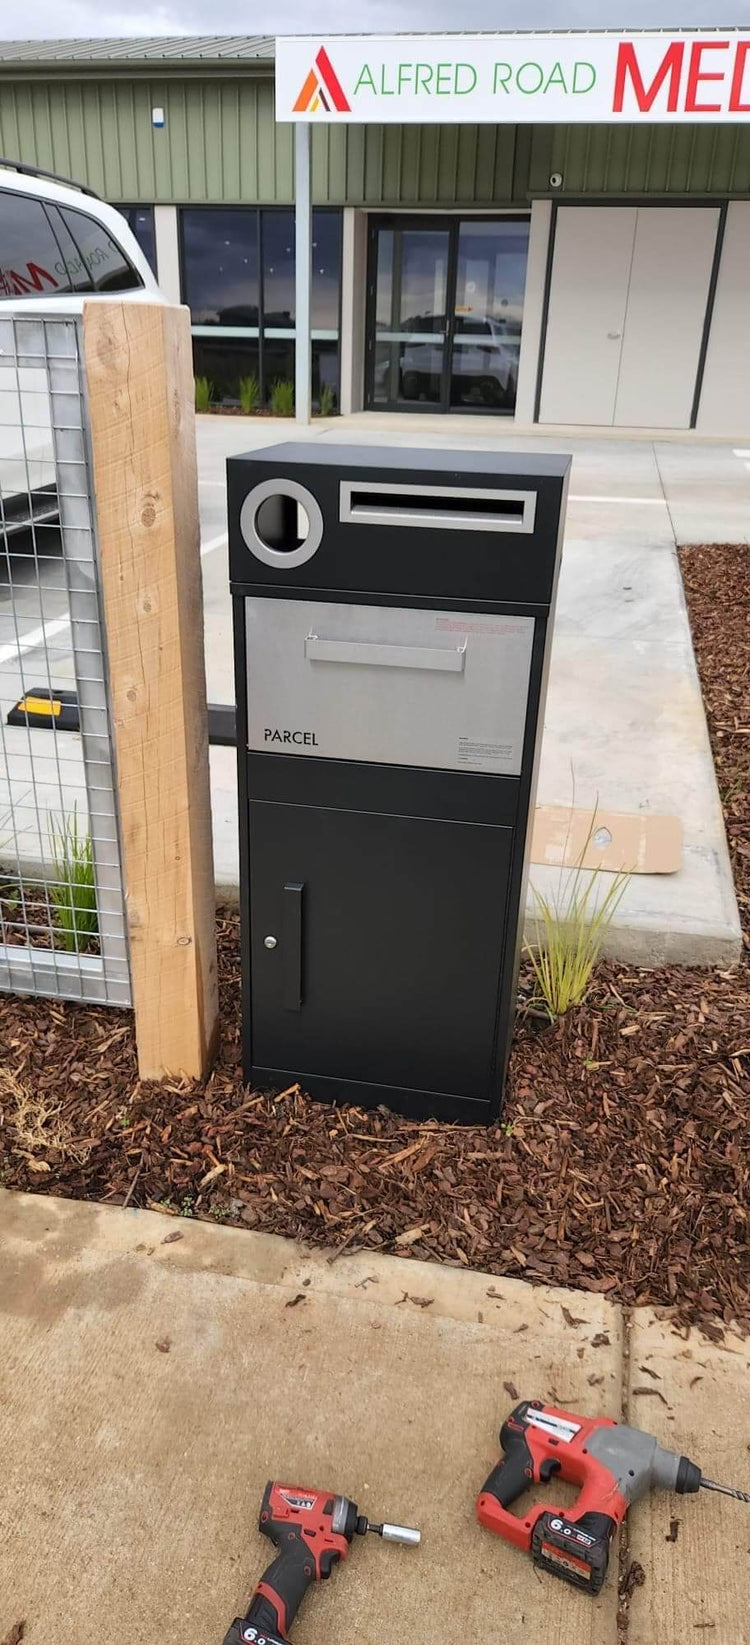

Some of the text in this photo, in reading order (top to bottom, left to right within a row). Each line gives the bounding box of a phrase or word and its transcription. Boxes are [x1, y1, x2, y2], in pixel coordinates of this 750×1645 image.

[353, 63, 478, 95] ALFRED
[492, 62, 597, 94] ROAD
[264, 728, 319, 746] PARCEL
[550, 1518, 572, 1535] 6.0
[243, 1627, 266, 1645] 6.0
